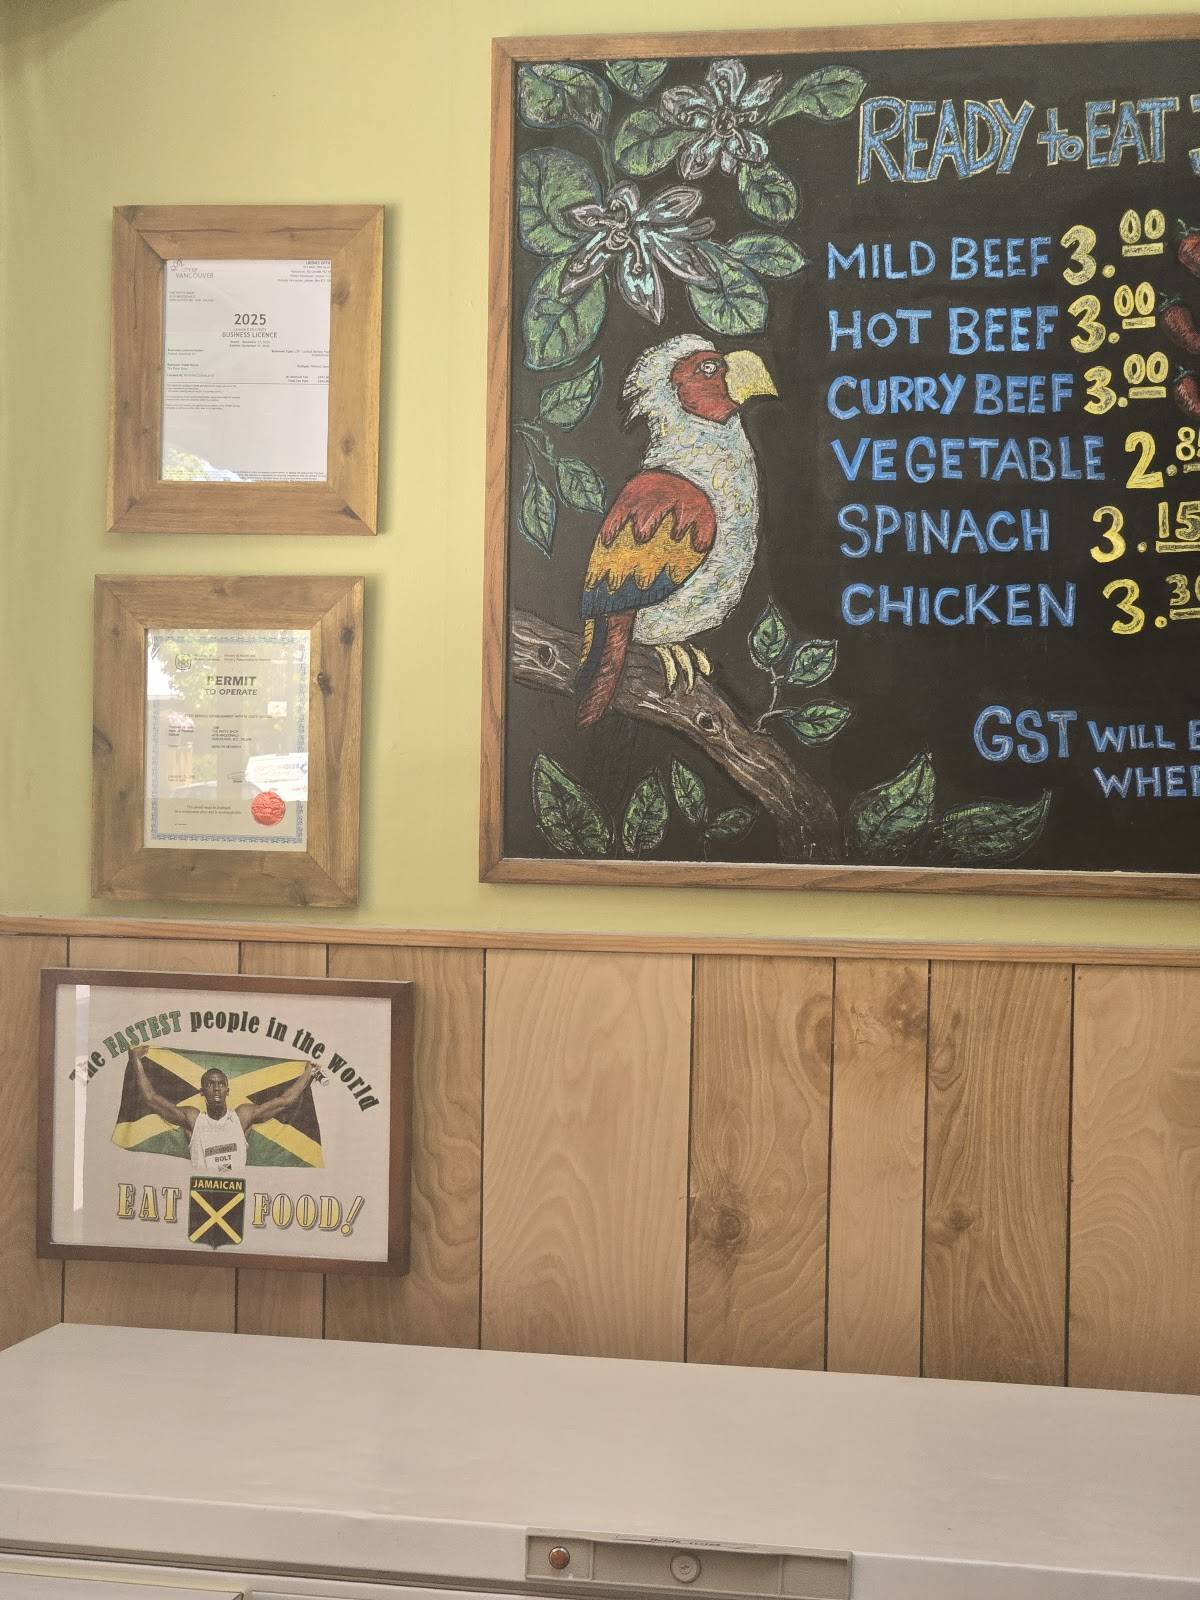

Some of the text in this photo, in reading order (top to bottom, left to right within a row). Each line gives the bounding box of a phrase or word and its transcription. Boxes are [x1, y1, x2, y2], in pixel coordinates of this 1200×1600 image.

[858, 96, 1035, 185] READY
[1037, 107, 1084, 166] to
[1086, 97, 1180, 169] EAT
[827, 241, 936, 280] MILD
[949, 236, 1052, 281] BEEF
[234, 313, 267, 326] 2025
[252, 331, 278, 339] LICENCE
[828, 308, 932, 351] HOT
[948, 305, 1059, 356] BEEF
[827, 372, 967, 420] CURRY
[973, 372, 1074, 416] BEEF
[831, 426, 1200, 489] VEGETABLE 2.8
[837, 503, 1050, 558] SPINACH
[841, 581, 1077, 627] CHICKEN
[206, 675, 257, 686] PERMIT
[218, 688, 258, 696] OPERATE
[973, 705, 1078, 764] GST
[1087, 719, 1176, 753] WILL
[102, 1010, 181, 1059] FASTEST
[190, 1010, 260, 1034] people
[265, 1016, 288, 1042] in
[292, 1028, 326, 1060] the
[327, 1052, 380, 1112] world
[214, 1154, 232, 1163] BOLT
[192, 1178, 243, 1191] JAMAICAN
[117, 1183, 366, 1237] EAT FOOD!
